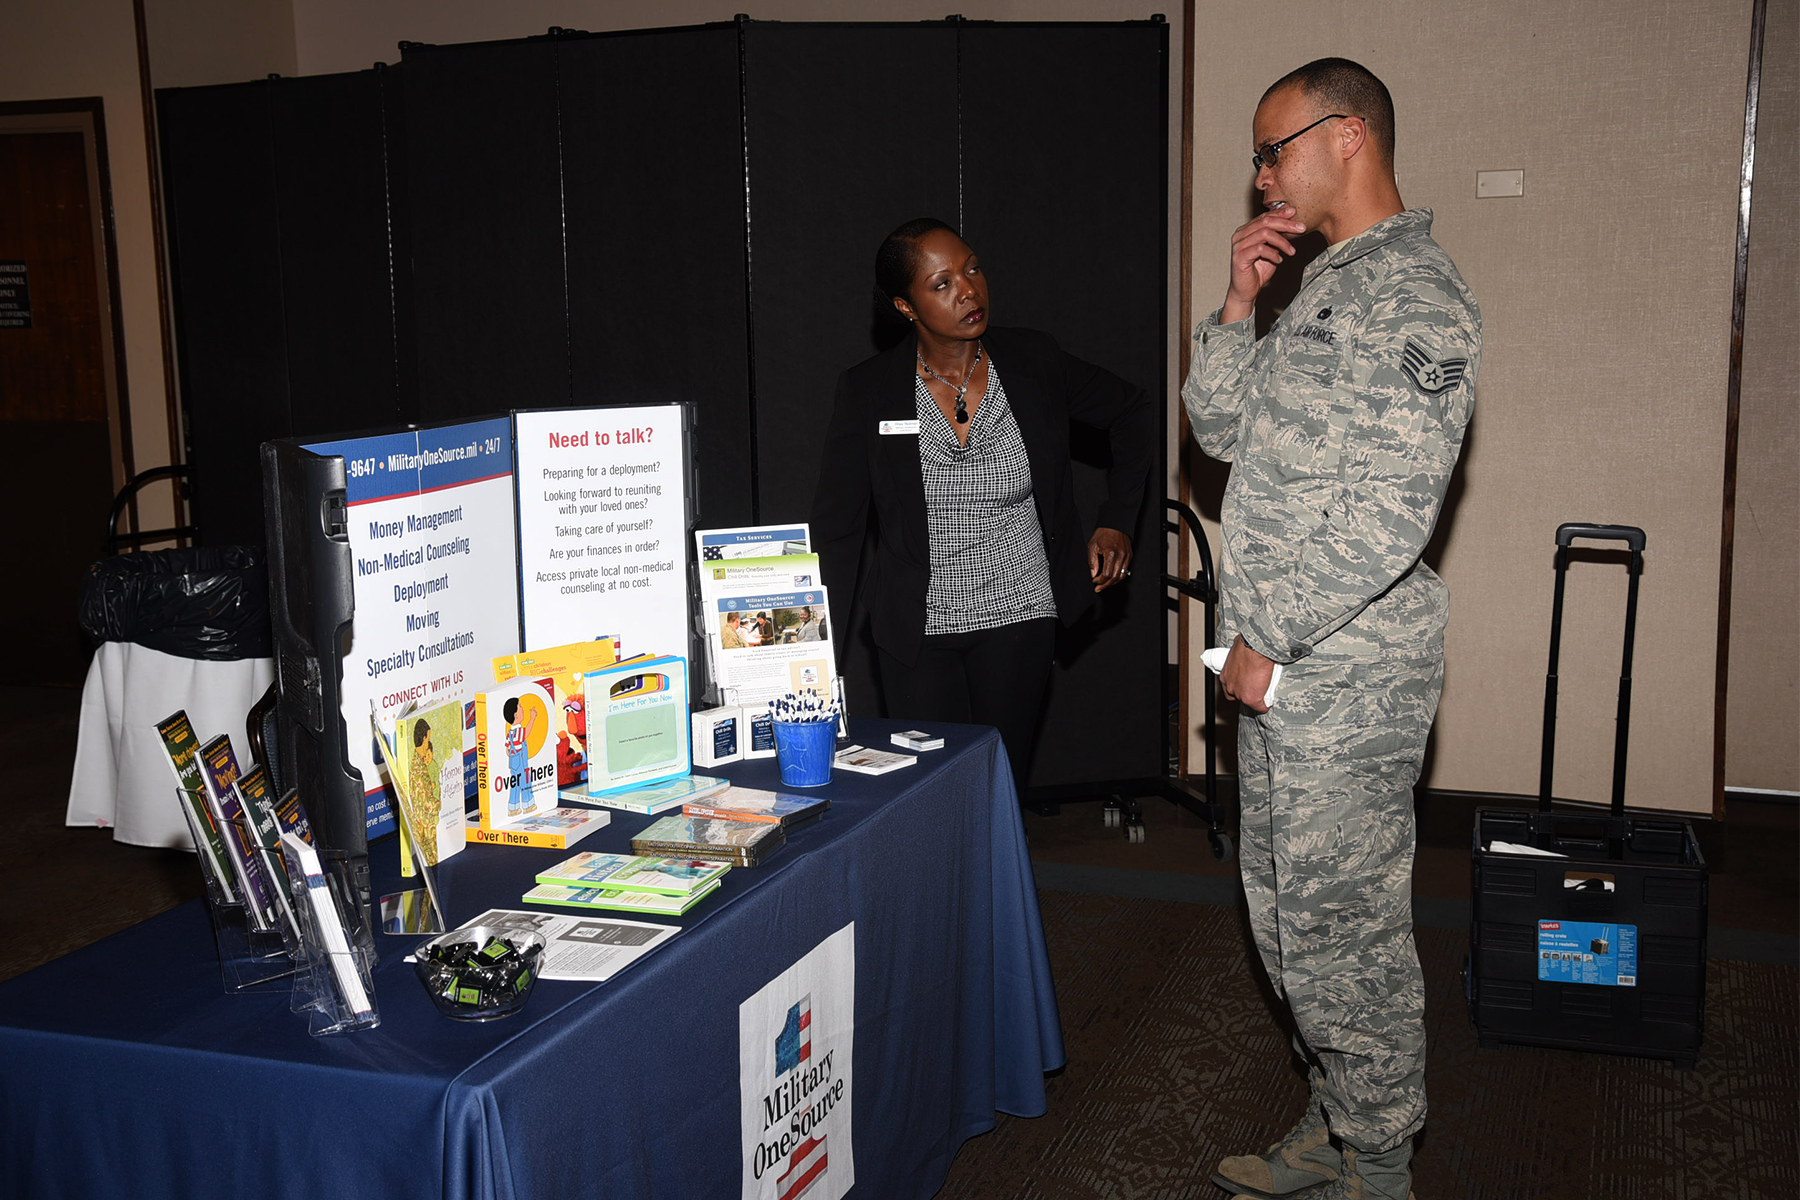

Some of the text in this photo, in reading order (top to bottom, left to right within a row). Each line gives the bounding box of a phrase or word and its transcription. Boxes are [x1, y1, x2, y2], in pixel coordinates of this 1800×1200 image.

[1309, 327, 1340, 346] FORCE
[549, 426, 654, 449] Need to talk?
[388, 441, 477, 472] MilitaryOneSource.mil
[485, 437, 501, 455] 24/7
[543, 461, 661, 480] Preparing for a deployment?
[544, 484, 662, 502] Looking forward to reuniting
[558, 497, 649, 516] with your loved ones?
[369, 504, 463, 540] Money Management
[555, 518, 653, 538] Taking care of yourself?
[358, 536, 470, 577] Non-Medical Counseling
[549, 540, 660, 561] Are your finances in order?
[536, 559, 674, 583] Access private local non-medical
[394, 573, 449, 604] Deployment
[560, 576, 652, 595] counseling at no cost.
[406, 610, 440, 633] Moving
[367, 630, 475, 679] Specialty Consultations
[382, 670, 464, 709] CONNECT WITH US
[608, 694, 673, 713] I'm Here For You Now
[477, 733, 488, 790] Over There
[440, 763, 463, 785] Home
[494, 772, 522, 793] Over
[524, 763, 554, 785] There
[367, 799, 386, 814] no cost
[366, 817, 378, 828] erve
[476, 829, 529, 844] Over There
[583, 861, 626, 881] listen
[763, 1048, 834, 1133] Military
[753, 1077, 844, 1181] OneSource
